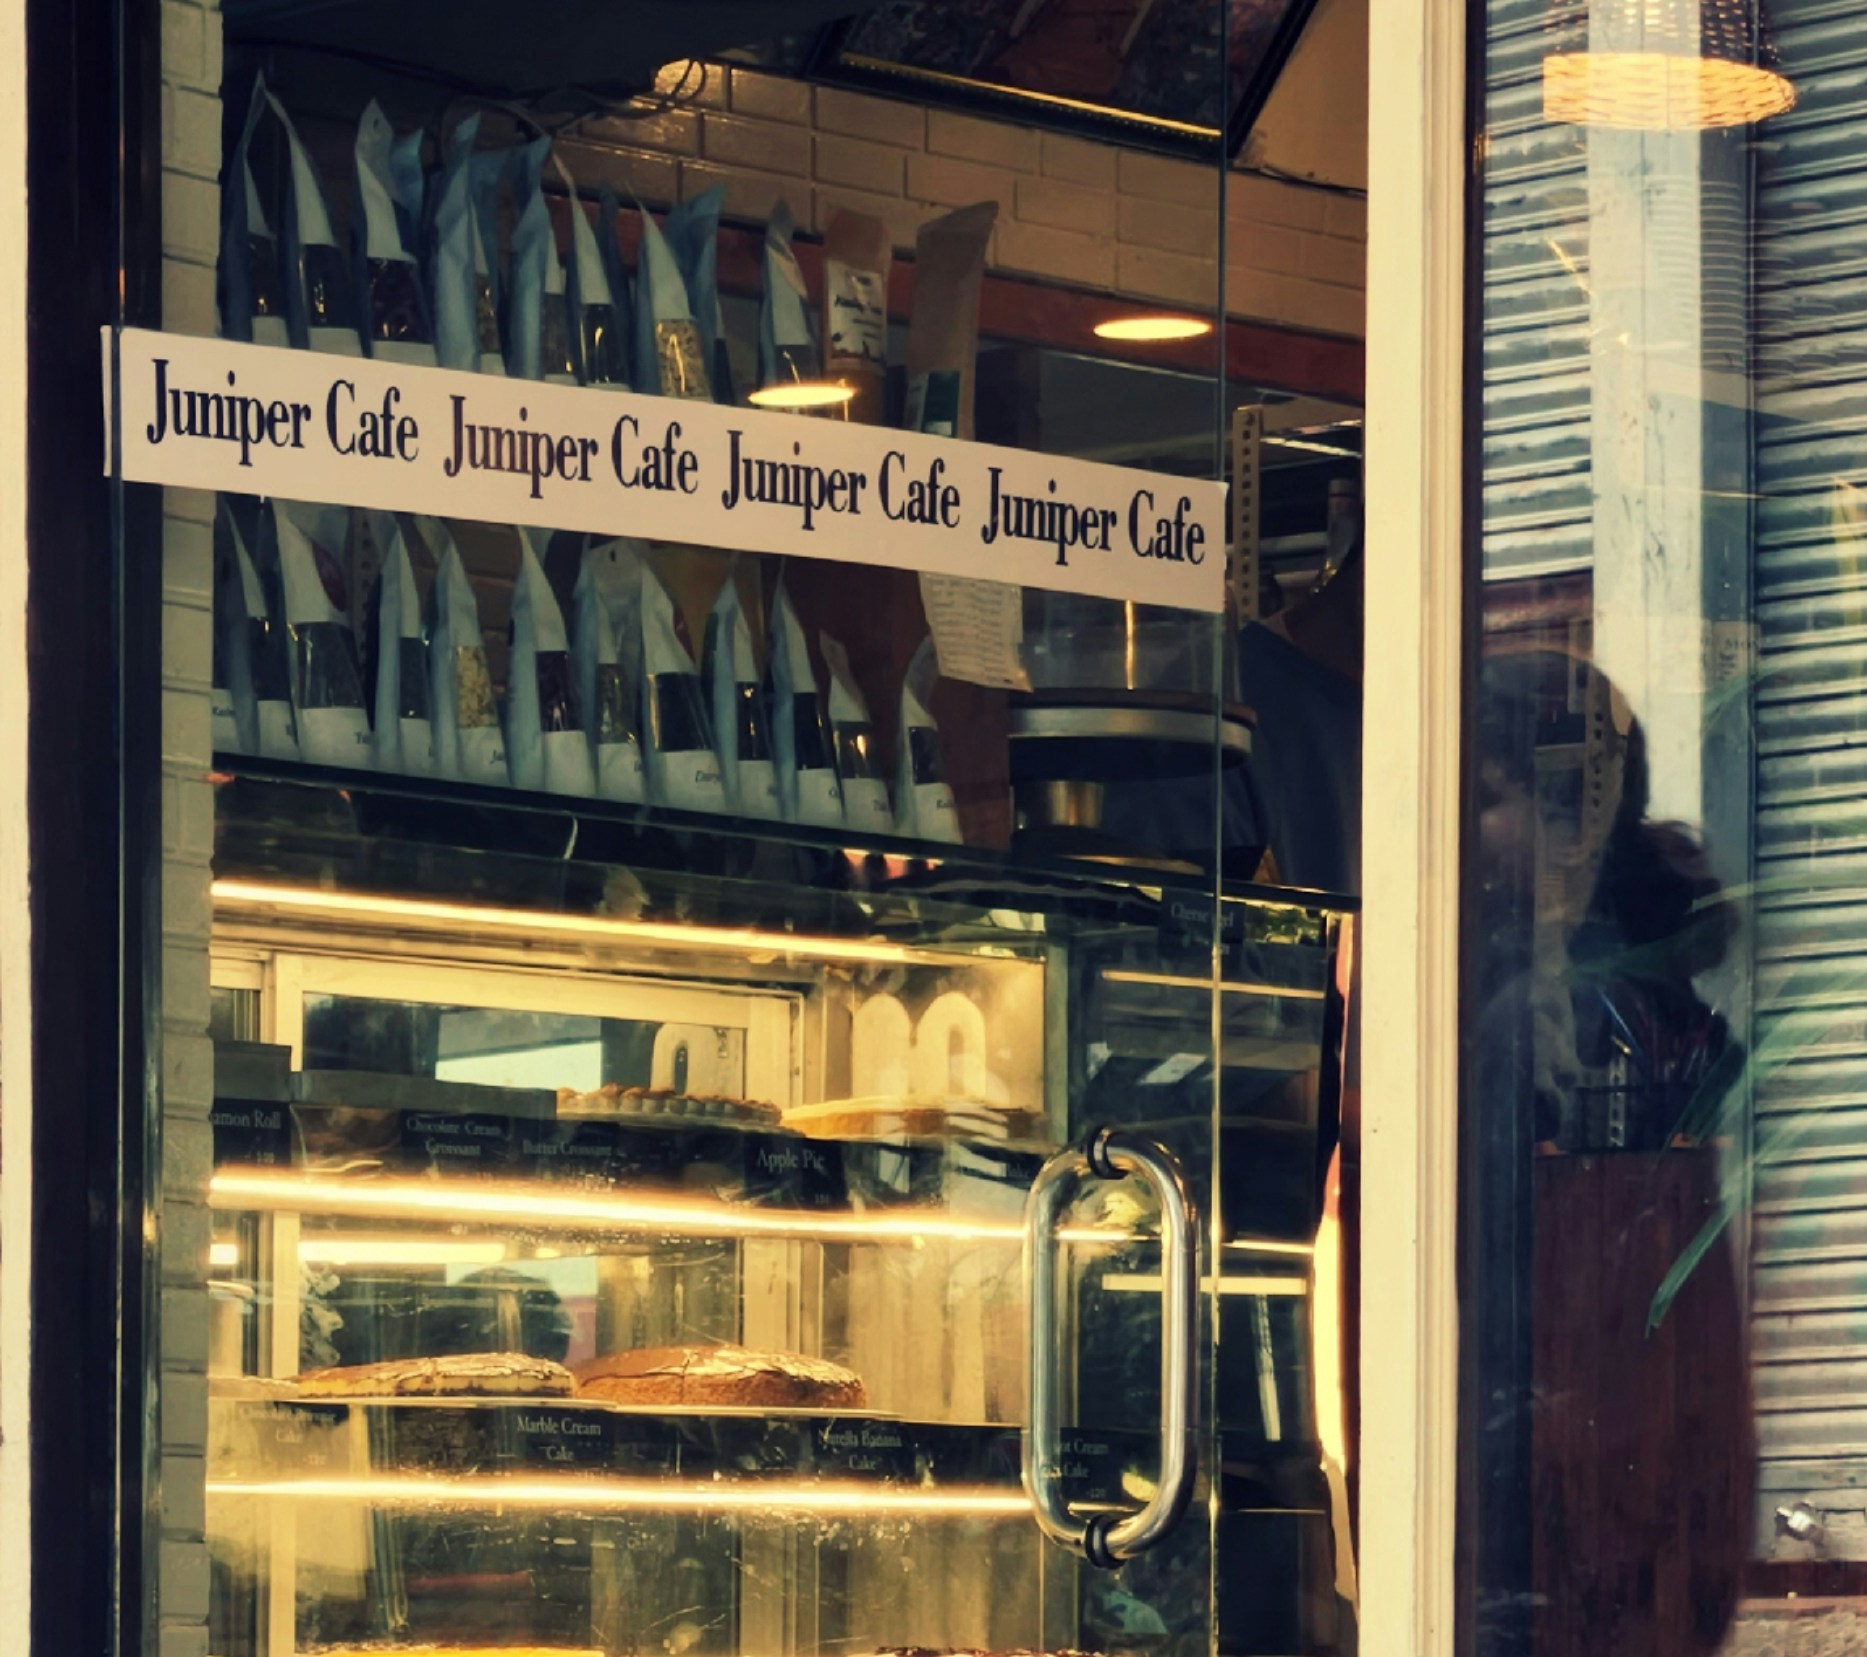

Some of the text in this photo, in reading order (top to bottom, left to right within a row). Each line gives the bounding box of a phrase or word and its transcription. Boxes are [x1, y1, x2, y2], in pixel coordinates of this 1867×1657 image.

[147, 359, 1206, 567] Juniper Cafe Juniper Cafe Juniper Cafe Juniper Cafe
[254, 1109, 282, 1130] Roll
[757, 1146, 826, 1173] Apple Pie
[516, 1414, 602, 1436] Marble Cream
[546, 1445, 575, 1461] Cake
